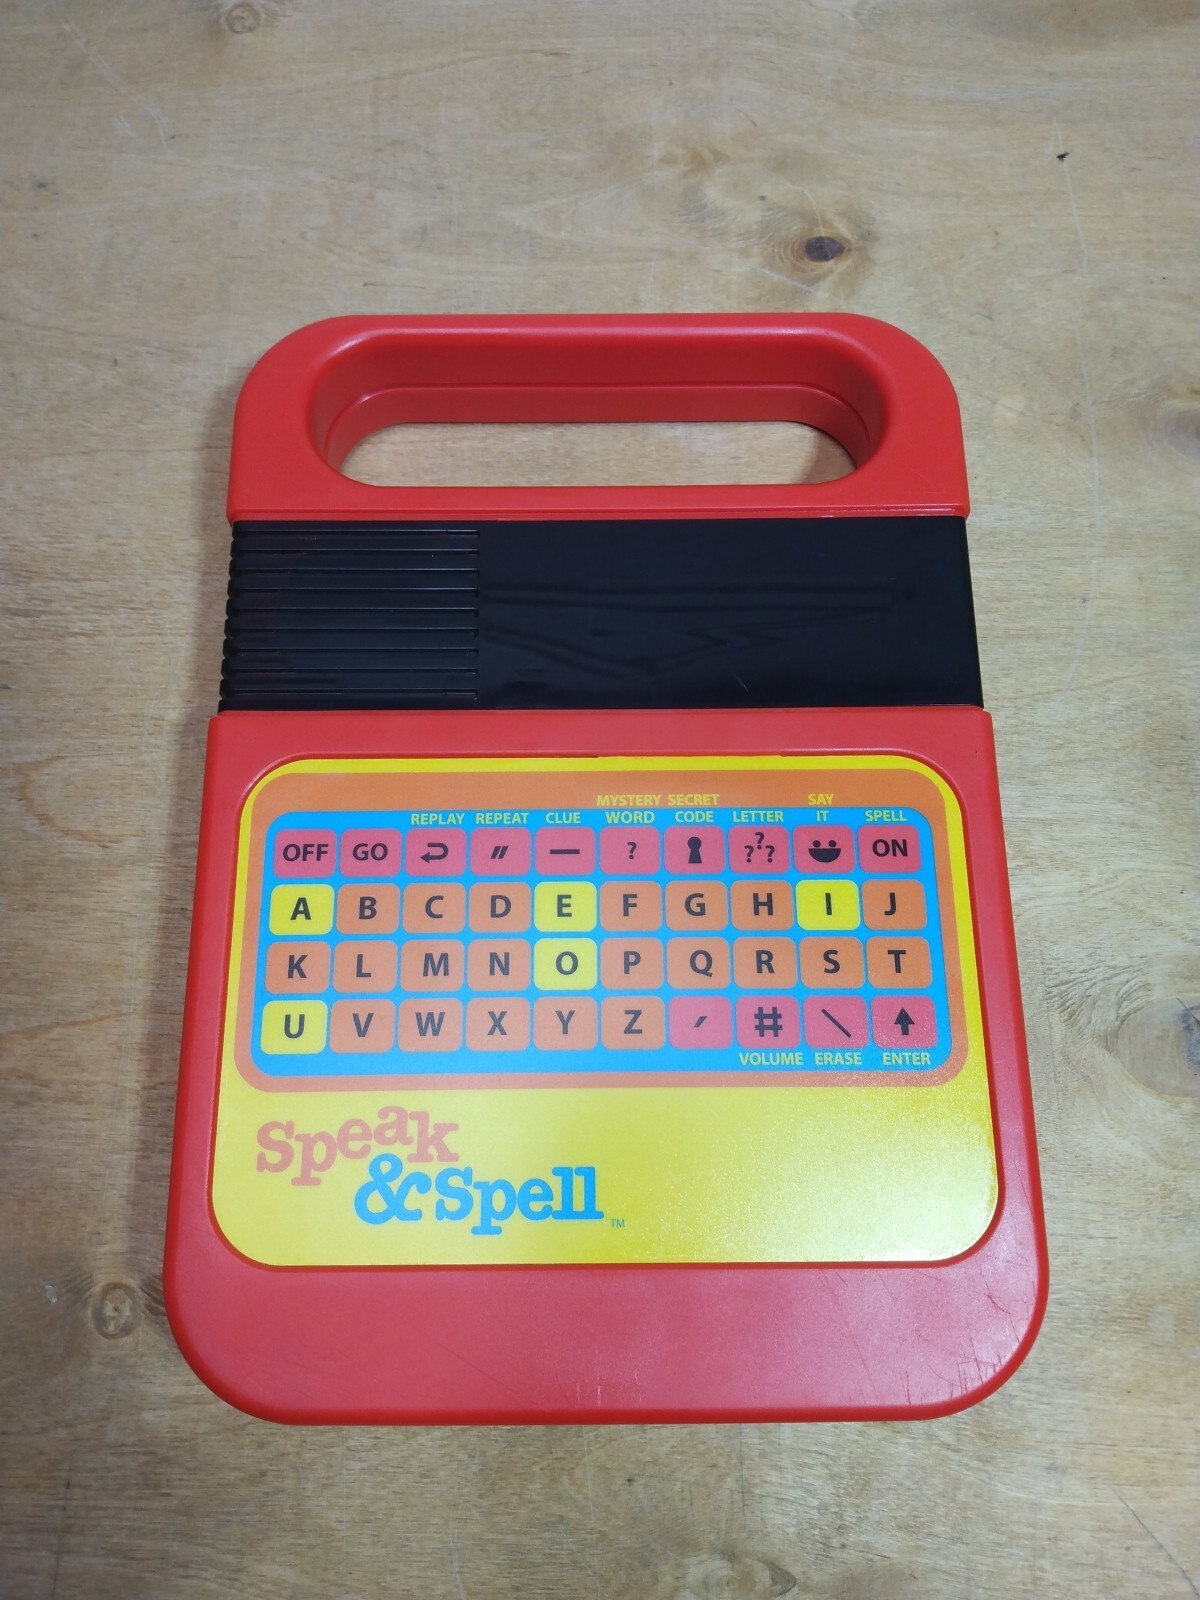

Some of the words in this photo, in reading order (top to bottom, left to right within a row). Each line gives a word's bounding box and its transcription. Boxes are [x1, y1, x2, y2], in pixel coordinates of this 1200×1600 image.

[597, 795, 661, 806] MYSTERY
[668, 795, 719, 806] SECRET
[808, 794, 834, 805] SAY
[411, 813, 465, 825] REPLAY
[476, 813, 529, 824] REPEAT
[546, 812, 581, 824] CLUE
[606, 812, 655, 824] WORD
[675, 811, 714, 823] CODE
[733, 811, 784, 823] LETTER
[817, 811, 828, 822] IT
[865, 810, 907, 822] SPELL
[282, 844, 329, 861] OFF
[352, 843, 388, 861] GO
[872, 839, 908, 857] ON
[290, 897, 311, 920] A
[359, 897, 377, 919] B
[425, 895, 444, 918] C
[490, 895, 511, 918] D
[557, 895, 572, 917] E
[623, 894, 638, 916] F
[685, 893, 706, 916] G
[753, 893, 774, 915] H
[825, 893, 832, 915] I
[885, 893, 897, 915] J
[287, 955, 308, 978] K
[356, 954, 371, 978] L
[423, 953, 450, 977] M
[490, 952, 510, 976] N
[556, 951, 578, 975] O
[624, 951, 641, 974] P
[690, 950, 713, 977] Q
[755, 951, 775, 974] R
[823, 950, 840, 973] S
[888, 950, 906, 973] T
[284, 1014, 305, 1038] U
[352, 1013, 374, 1037] V
[415, 1012, 445, 1036] W
[487, 1011, 507, 1035] X
[556, 1010, 575, 1034] Y
[624, 1010, 642, 1034] Z
[739, 1053, 803, 1065] VOLUME
[815, 1053, 862, 1065] ERASE
[883, 1053, 931, 1065] ENTER
[256, 1105, 460, 1186] Speak
